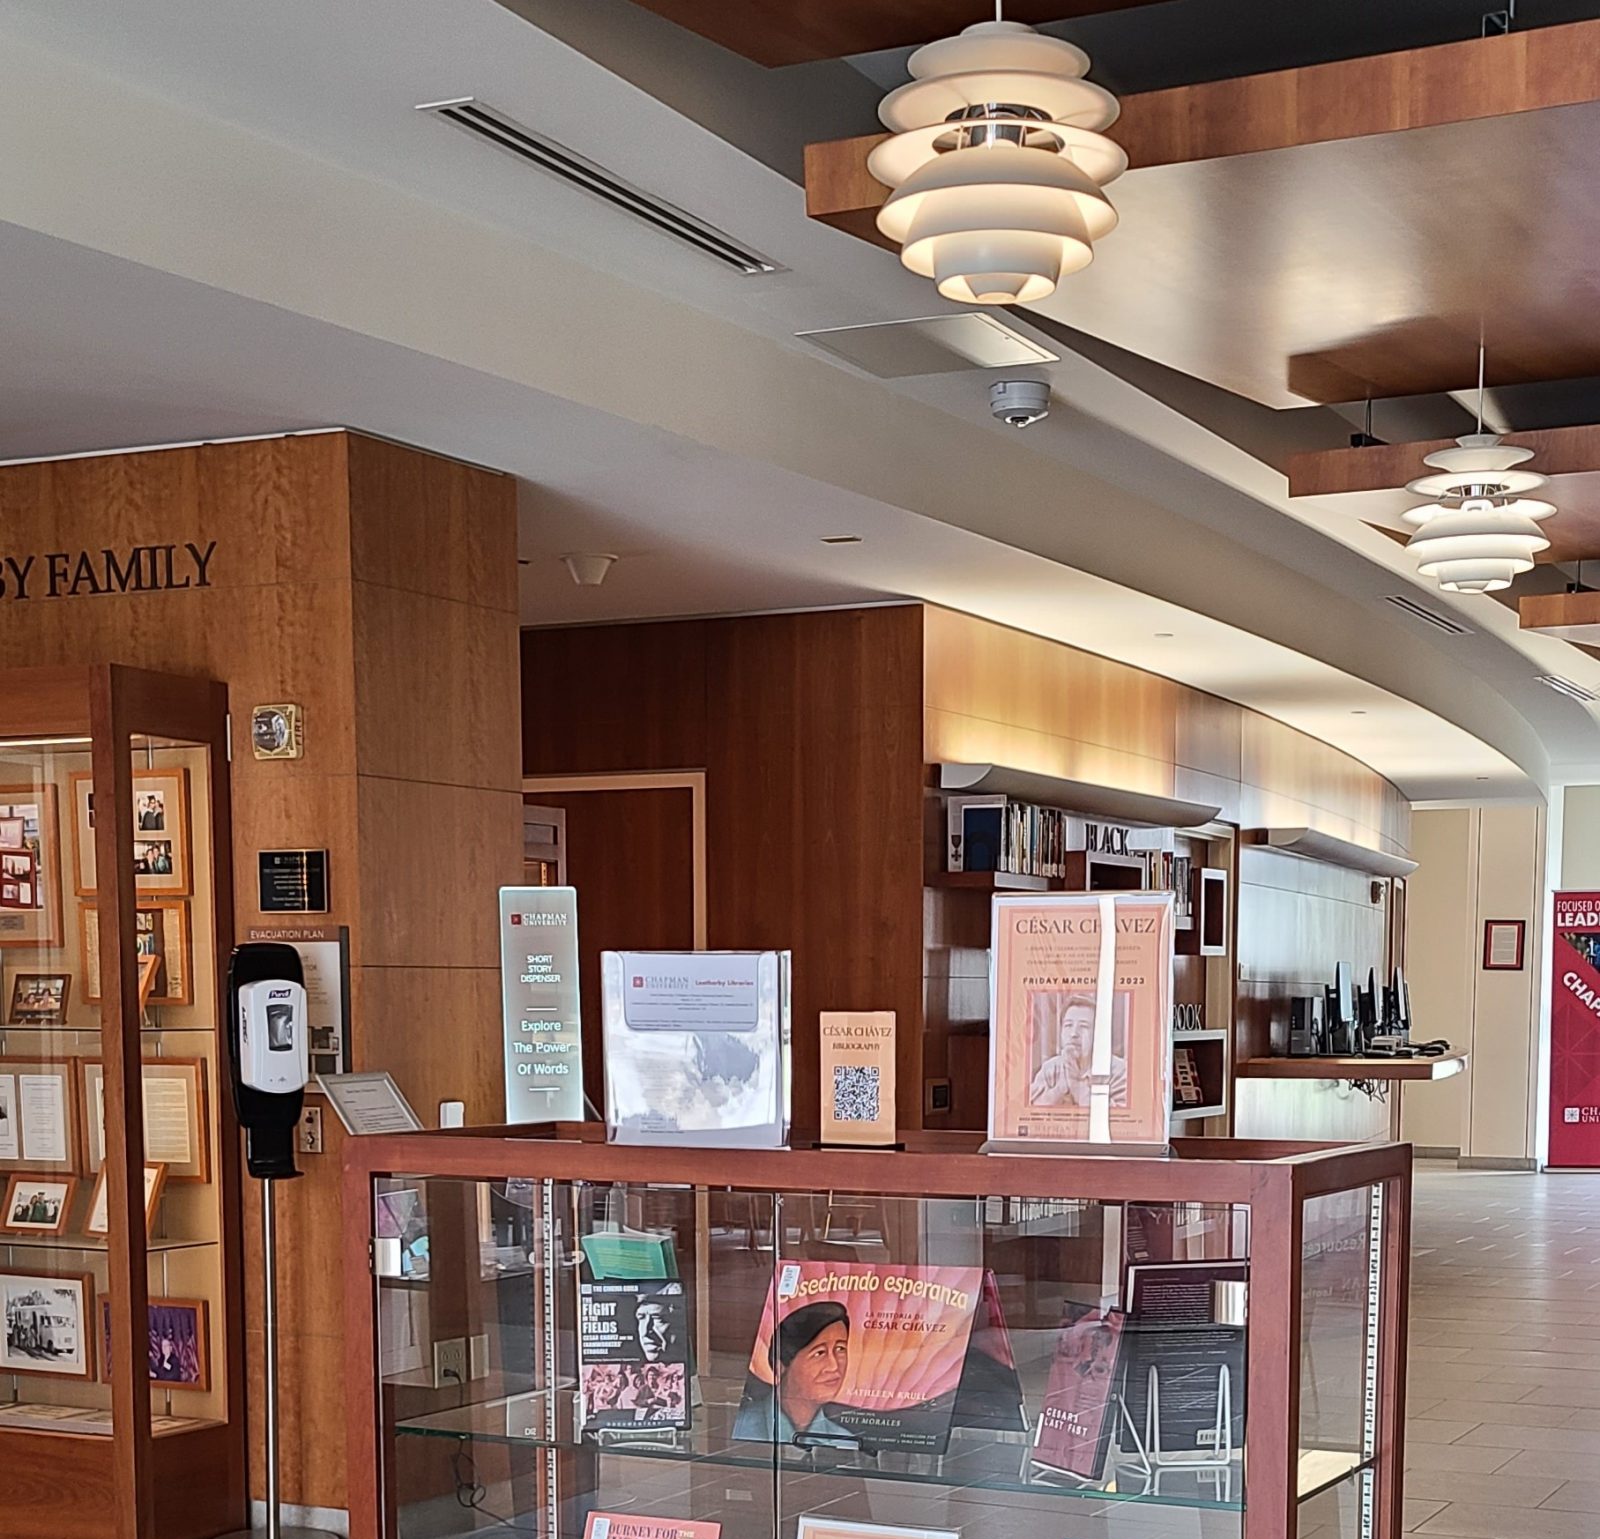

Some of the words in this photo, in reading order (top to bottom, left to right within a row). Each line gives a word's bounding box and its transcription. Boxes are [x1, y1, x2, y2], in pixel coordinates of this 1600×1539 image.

[0, 556, 35, 600] Y
[45, 541, 217, 597] FAMILY
[1085, 823, 1130, 856] BLACK
[1557, 900, 1593, 912] FOCUSED
[1016, 916, 1073, 934] CÉSAR
[1557, 912, 1600, 927] LEAD
[250, 930, 301, 939] EVACUATION
[303, 930, 324, 939] PLAN
[527, 954, 553, 963] SHORT
[528, 965, 552, 973] STORY
[520, 974, 561, 983] DISPENSER
[1022, 977, 1059, 985] FRIDAY
[1062, 977, 1097, 985] MARCH
[1119, 977, 1145, 985] 2023
[1563, 971, 1600, 1017] CHAP
[521, 1020, 562, 1033] Explore
[823, 1024, 853, 1036] CÉSAR
[513, 1042, 533, 1053] The
[536, 1042, 571, 1053] Power
[517, 1063, 532, 1075] Of
[533, 1063, 569, 1075] Words
[1581, 1106, 1600, 1115] CH
[779, 1271, 880, 1304] osechando
[883, 1275, 969, 1310] esperanza
[582, 1302, 617, 1316] FIGHT
[582, 1321, 617, 1334] FIELDS
[846, 1388, 894, 1399] KATHLEEN
[896, 1390, 927, 1400] KRULL
[861, 1417, 901, 1427] MORALES
[1044, 1417, 1065, 1430] LAST
[608, 1523, 652, 1538] OURNEY
[655, 1528, 678, 1539] FOR
[679, 1530, 694, 1538] THE
